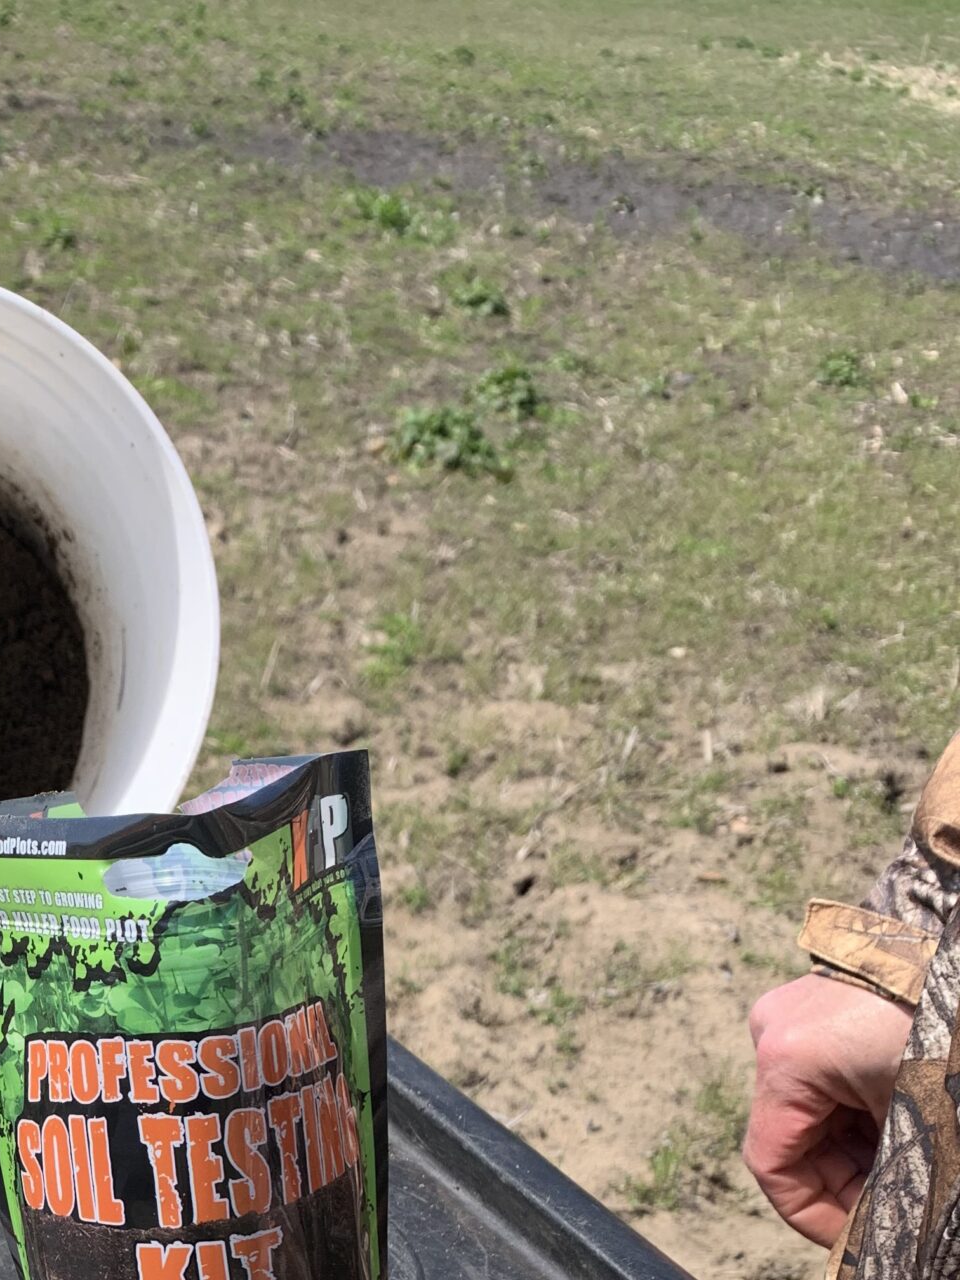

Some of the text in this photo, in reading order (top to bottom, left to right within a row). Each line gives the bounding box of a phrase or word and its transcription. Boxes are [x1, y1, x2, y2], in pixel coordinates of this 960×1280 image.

[12, 889, 36, 905] STEP
[39, 891, 52, 906] TO
[54, 892, 103, 909] GROWING
[12, 911, 60, 936] KILLER
[62, 916, 100, 940] FOOD
[105, 918, 150, 943] PLOT
[17, 1114, 125, 1226] SOIL
